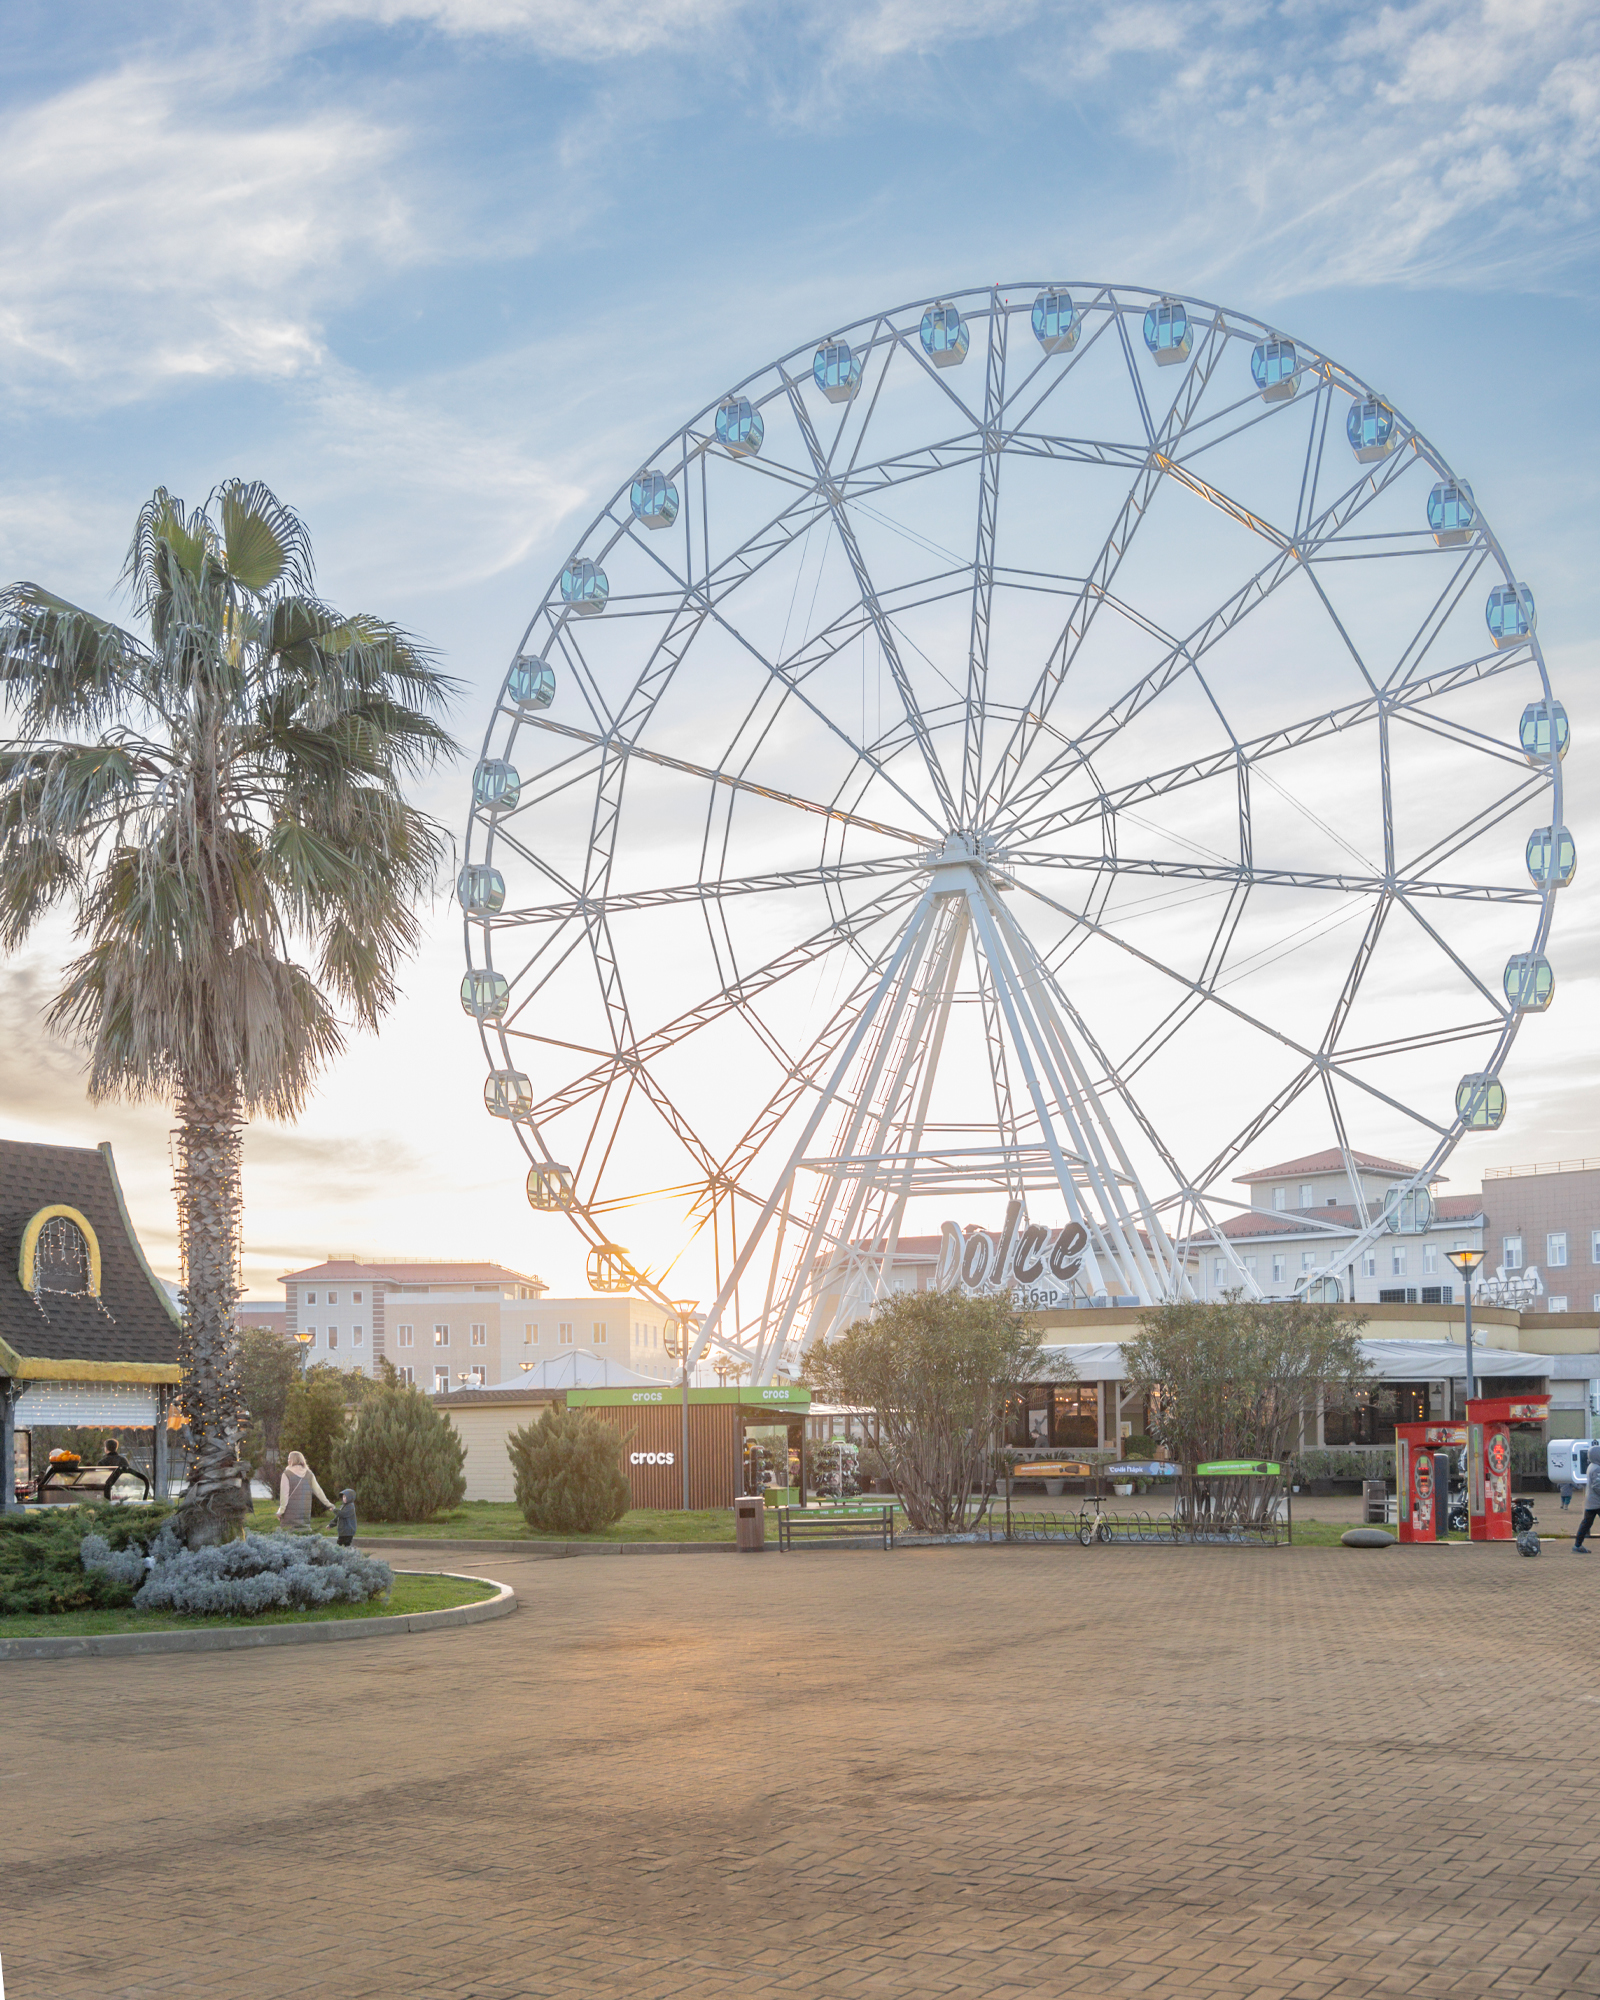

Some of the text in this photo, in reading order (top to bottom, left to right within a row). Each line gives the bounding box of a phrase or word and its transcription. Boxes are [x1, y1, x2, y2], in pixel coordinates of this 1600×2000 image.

[936, 1200, 1091, 1294] Dolce
[1030, 1288, 1058, 1304] бар
[632, 1391, 663, 1402] crocs
[762, 1388, 790, 1400] crocs
[630, 1452, 675, 1465] crocs
